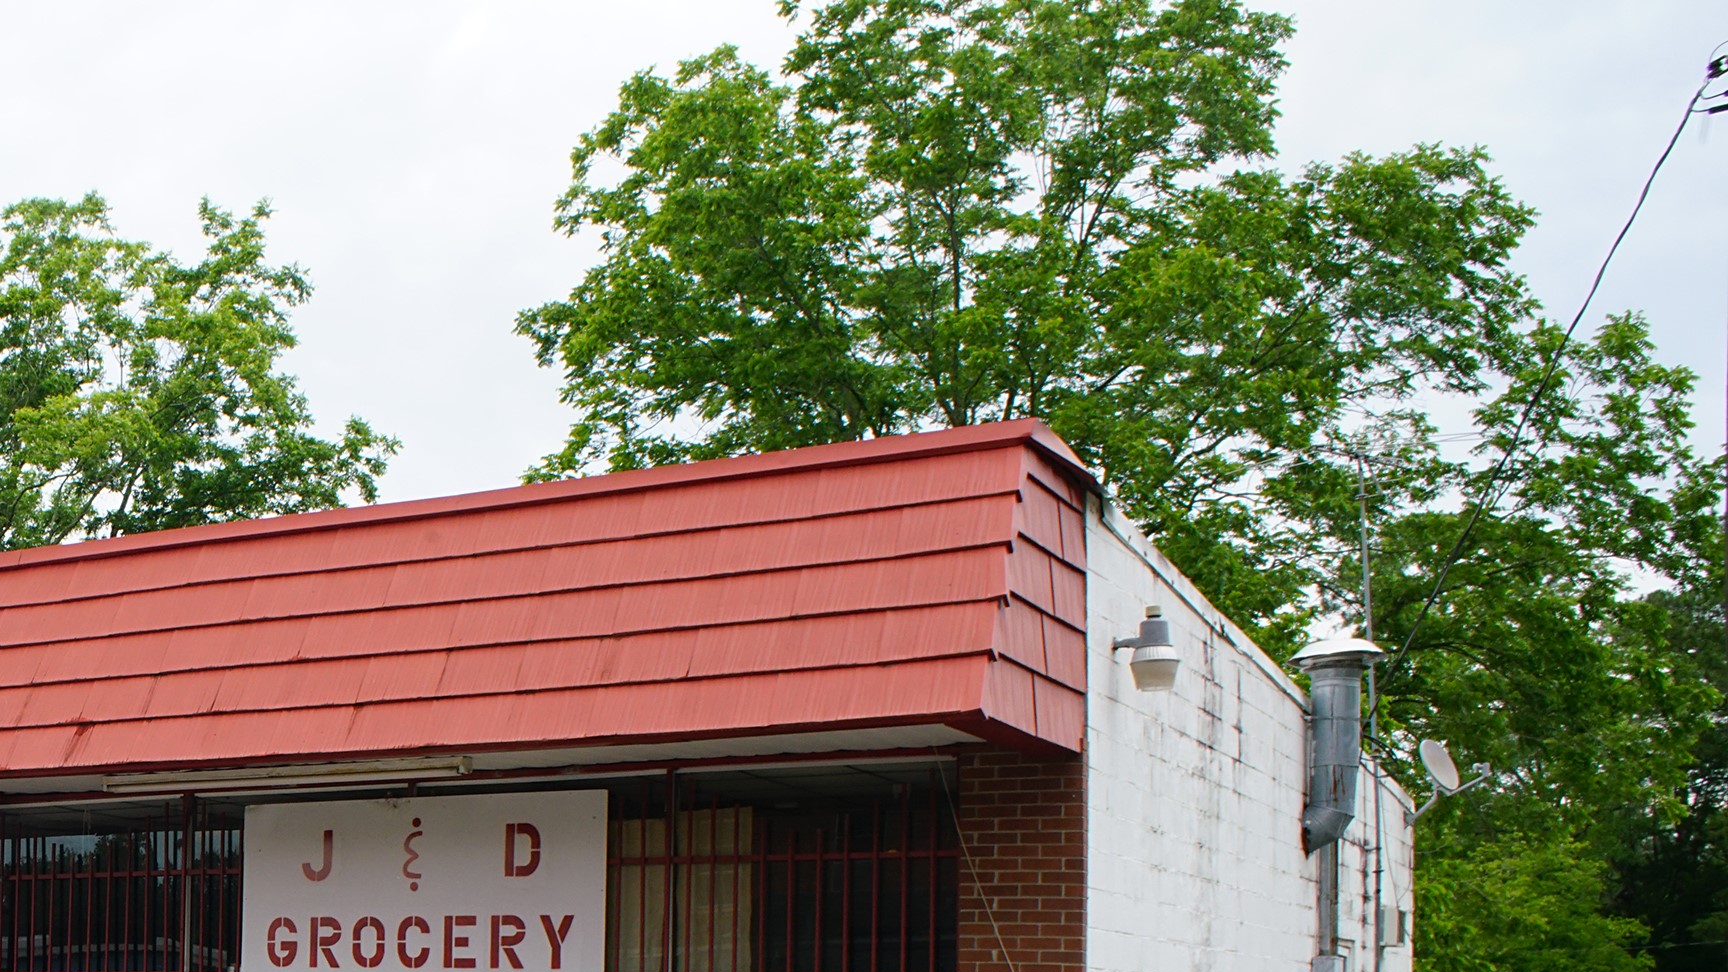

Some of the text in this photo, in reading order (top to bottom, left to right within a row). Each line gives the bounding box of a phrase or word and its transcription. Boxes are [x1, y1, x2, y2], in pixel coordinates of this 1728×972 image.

[301, 829, 334, 882] J
[504, 822, 541, 878] D
[267, 914, 574, 970] GROCERY
